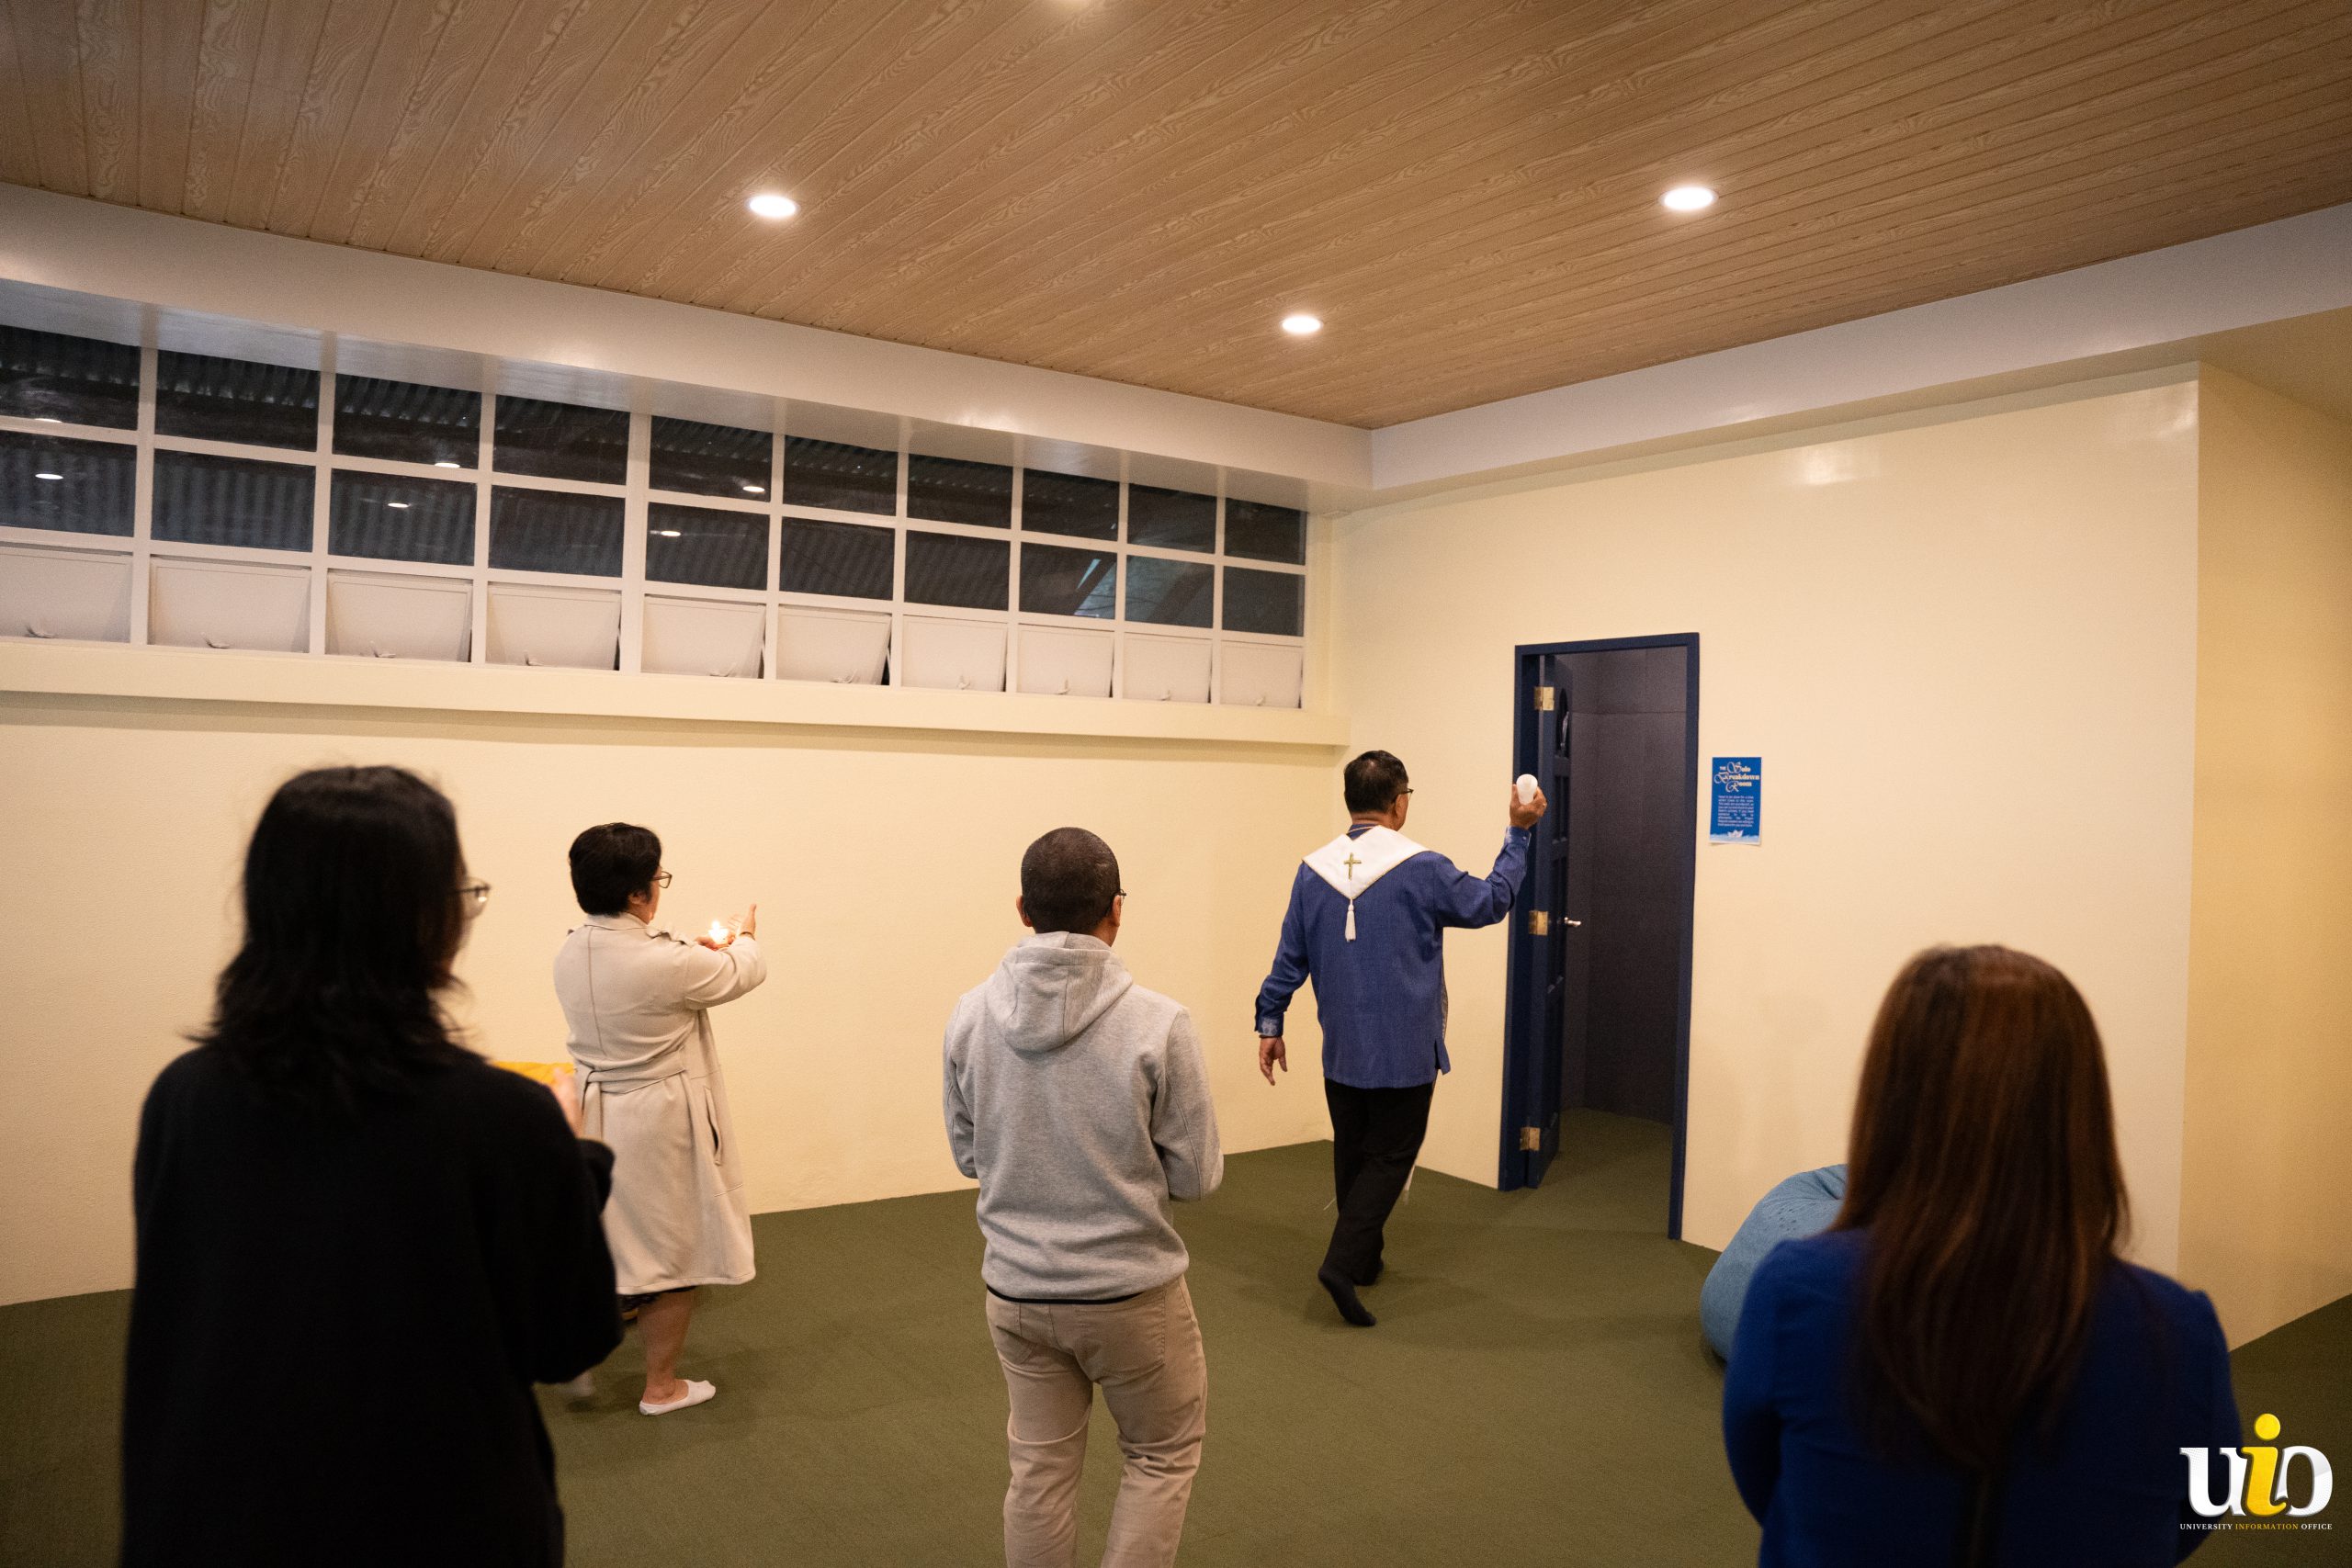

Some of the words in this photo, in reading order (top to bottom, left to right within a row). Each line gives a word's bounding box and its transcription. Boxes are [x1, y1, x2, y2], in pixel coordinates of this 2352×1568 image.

[1727, 761, 1751, 773] Solo
[1713, 772, 1759, 784] Breakdown
[1725, 781, 1752, 793] Room
